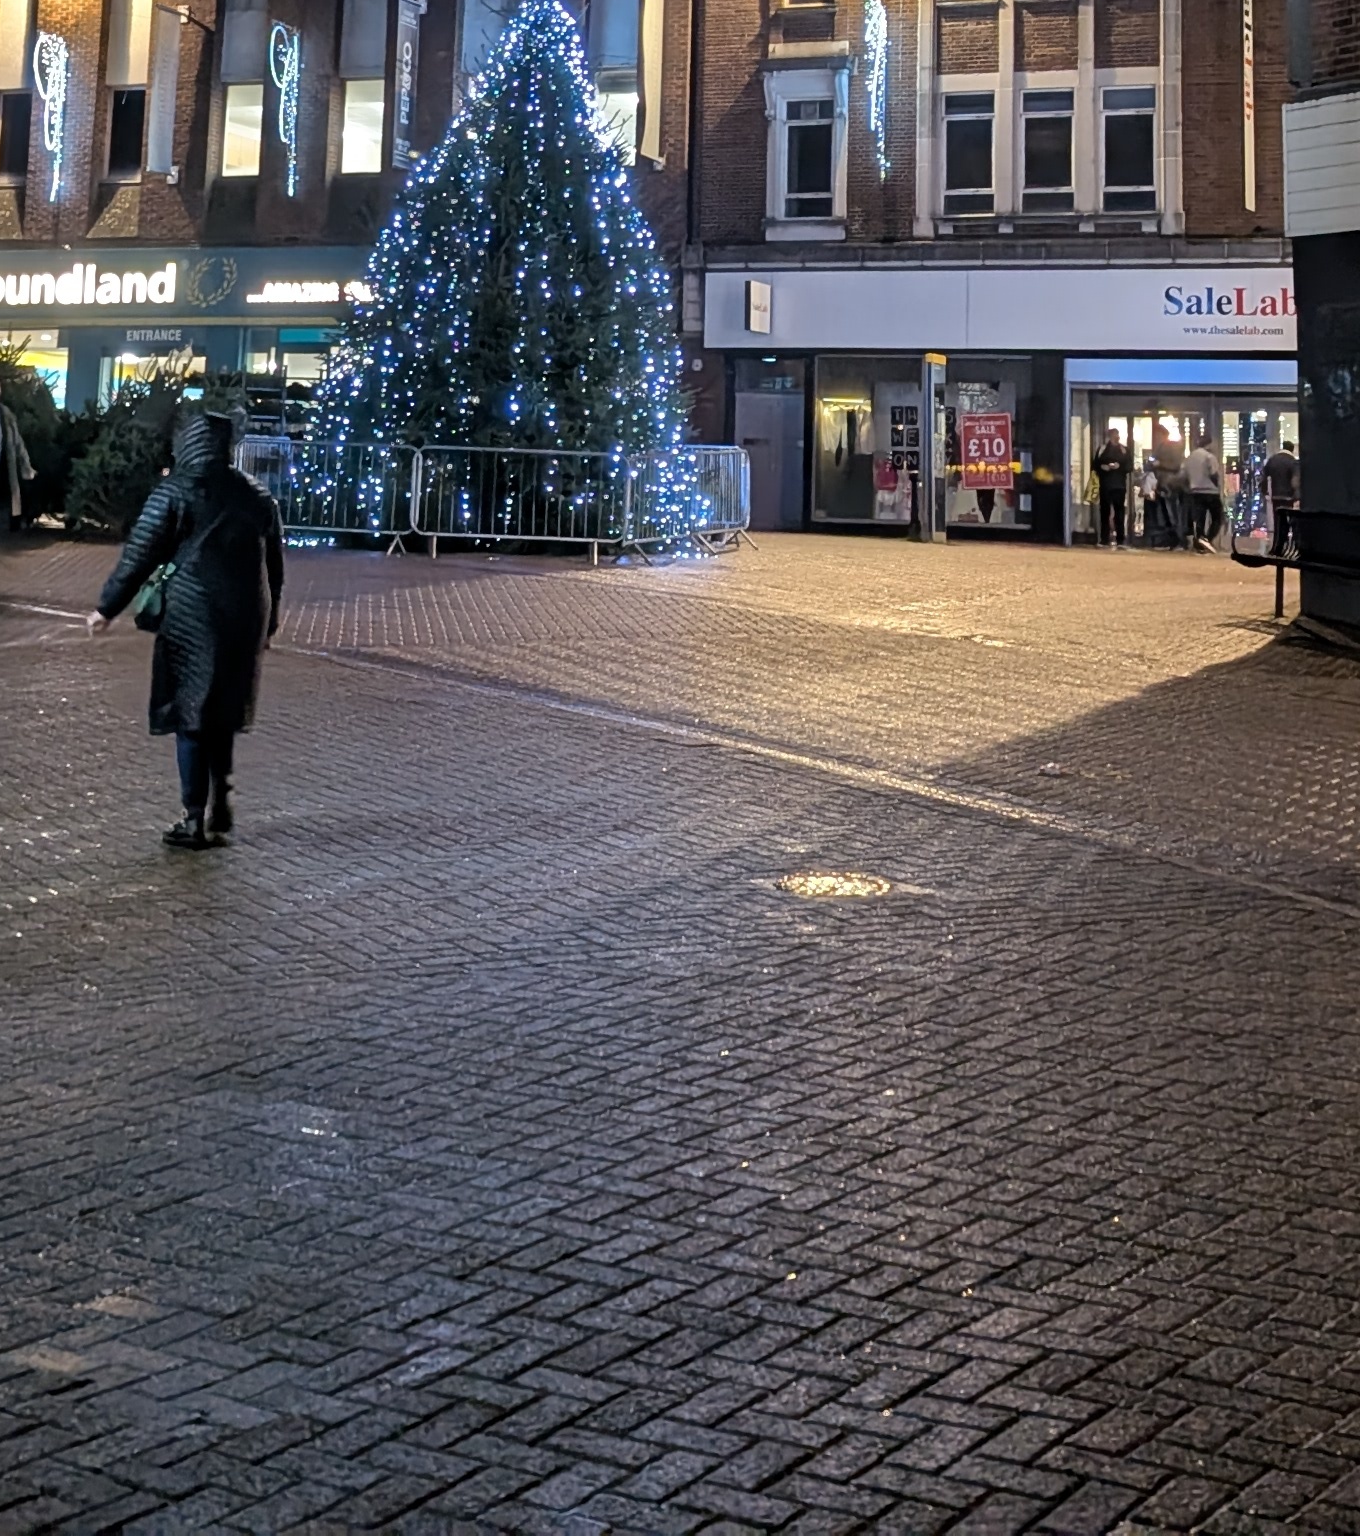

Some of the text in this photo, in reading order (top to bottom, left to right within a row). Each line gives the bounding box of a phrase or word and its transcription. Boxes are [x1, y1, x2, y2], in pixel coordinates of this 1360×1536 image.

[1164, 286, 1298, 316] SaleLab
[126, 329, 182, 341] ENTRANCE
[1182, 325, 1284, 336] www.thesalelab.com
[975, 425, 996, 435] SALE
[968, 437, 1006, 457] £10
